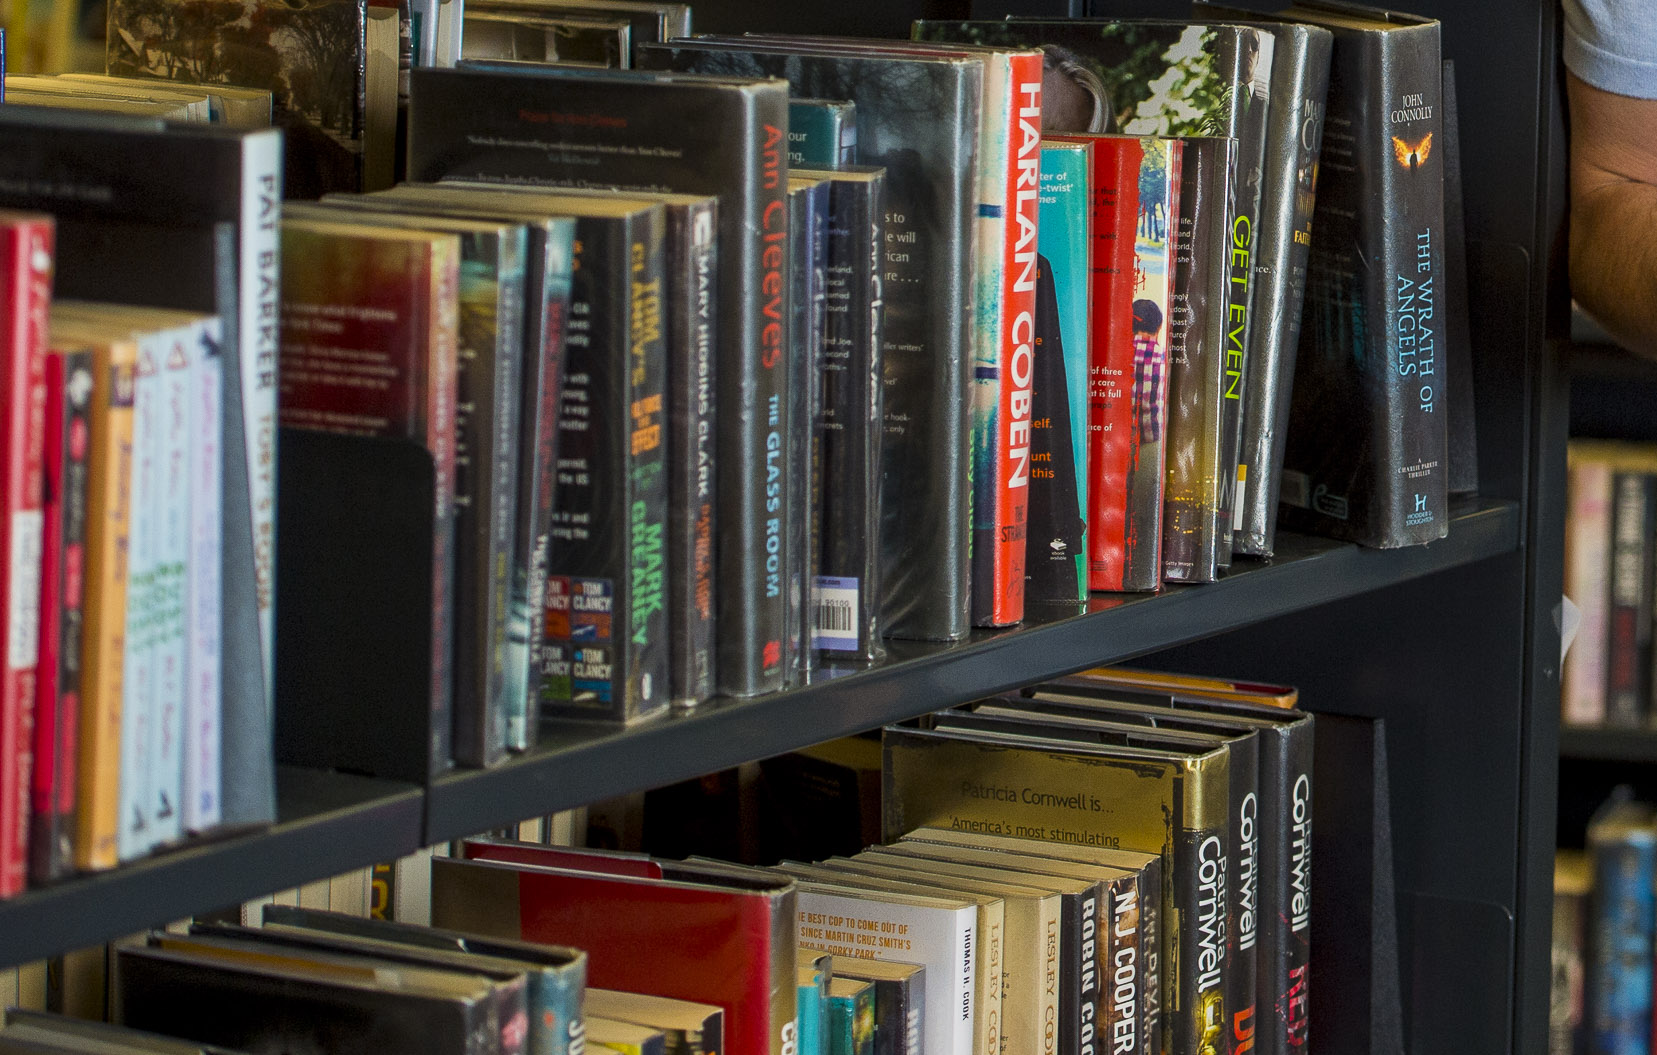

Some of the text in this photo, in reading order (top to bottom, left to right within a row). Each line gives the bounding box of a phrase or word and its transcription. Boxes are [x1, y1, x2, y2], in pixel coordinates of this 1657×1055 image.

[1391, 105, 1433, 124] CONNOLLY
[1402, 93, 1424, 110] JOHN
[1056, 172, 1067, 181] of
[762, 124, 787, 369] Ann Cleeves
[893, 213, 905, 224] to
[896, 231, 916, 243] will
[1232, 215, 1251, 293] GET
[256, 174, 275, 391] PAT BARKER
[697, 254, 709, 318] MARY
[1007, 82, 1042, 489] HARLAN COBEN
[1417, 227, 1435, 414] THE WRATH OF
[1224, 303, 1246, 400] EVEN
[1397, 273, 1417, 376] ANGELS
[697, 324, 709, 416] HIGGINS
[1097, 379, 1116, 387] care
[1099, 389, 1122, 398] is full
[1101, 367, 1123, 376] three
[697, 421, 709, 499] CLARK
[1103, 423, 1113, 432] of
[766, 394, 781, 598] THE GLASS ROOM
[1031, 468, 1055, 479] this
[573, 594, 612, 613] CLANCY
[582, 581, 604, 598] TOM
[631, 500, 648, 645] GREANEY
[646, 522, 663, 612] MARK
[573, 661, 612, 680] CLANCY
[582, 647, 604, 664] TOM
[960, 780, 1115, 815] Patricia Cornwell is...
[1015, 824, 1046, 840] most
[1049, 828, 1121, 851] stimulating
[1239, 792, 1257, 951] Cornwell
[1291, 773, 1310, 933] Cornwell
[800, 926, 823, 939] SINCE
[825, 929, 855, 944] MARTIN
[856, 934, 877, 947] CRUZ
[807, 912, 909, 935] BEST COP TO COME OUT OF
[1081, 897, 1096, 994] ROBIN
[1197, 835, 1222, 994] Cornwell
[1217, 855, 1228, 962] Patricia
[827, 945, 854, 958] GORKY
[961, 927, 973, 1021] THOMAS H. COOK
[989, 923, 1000, 1001] LESLEY
[1045, 918, 1058, 996] LESLEY
[1112, 890, 1137, 1055] N.J. COOPER
[1148, 952, 1160, 1034] DEVIL
